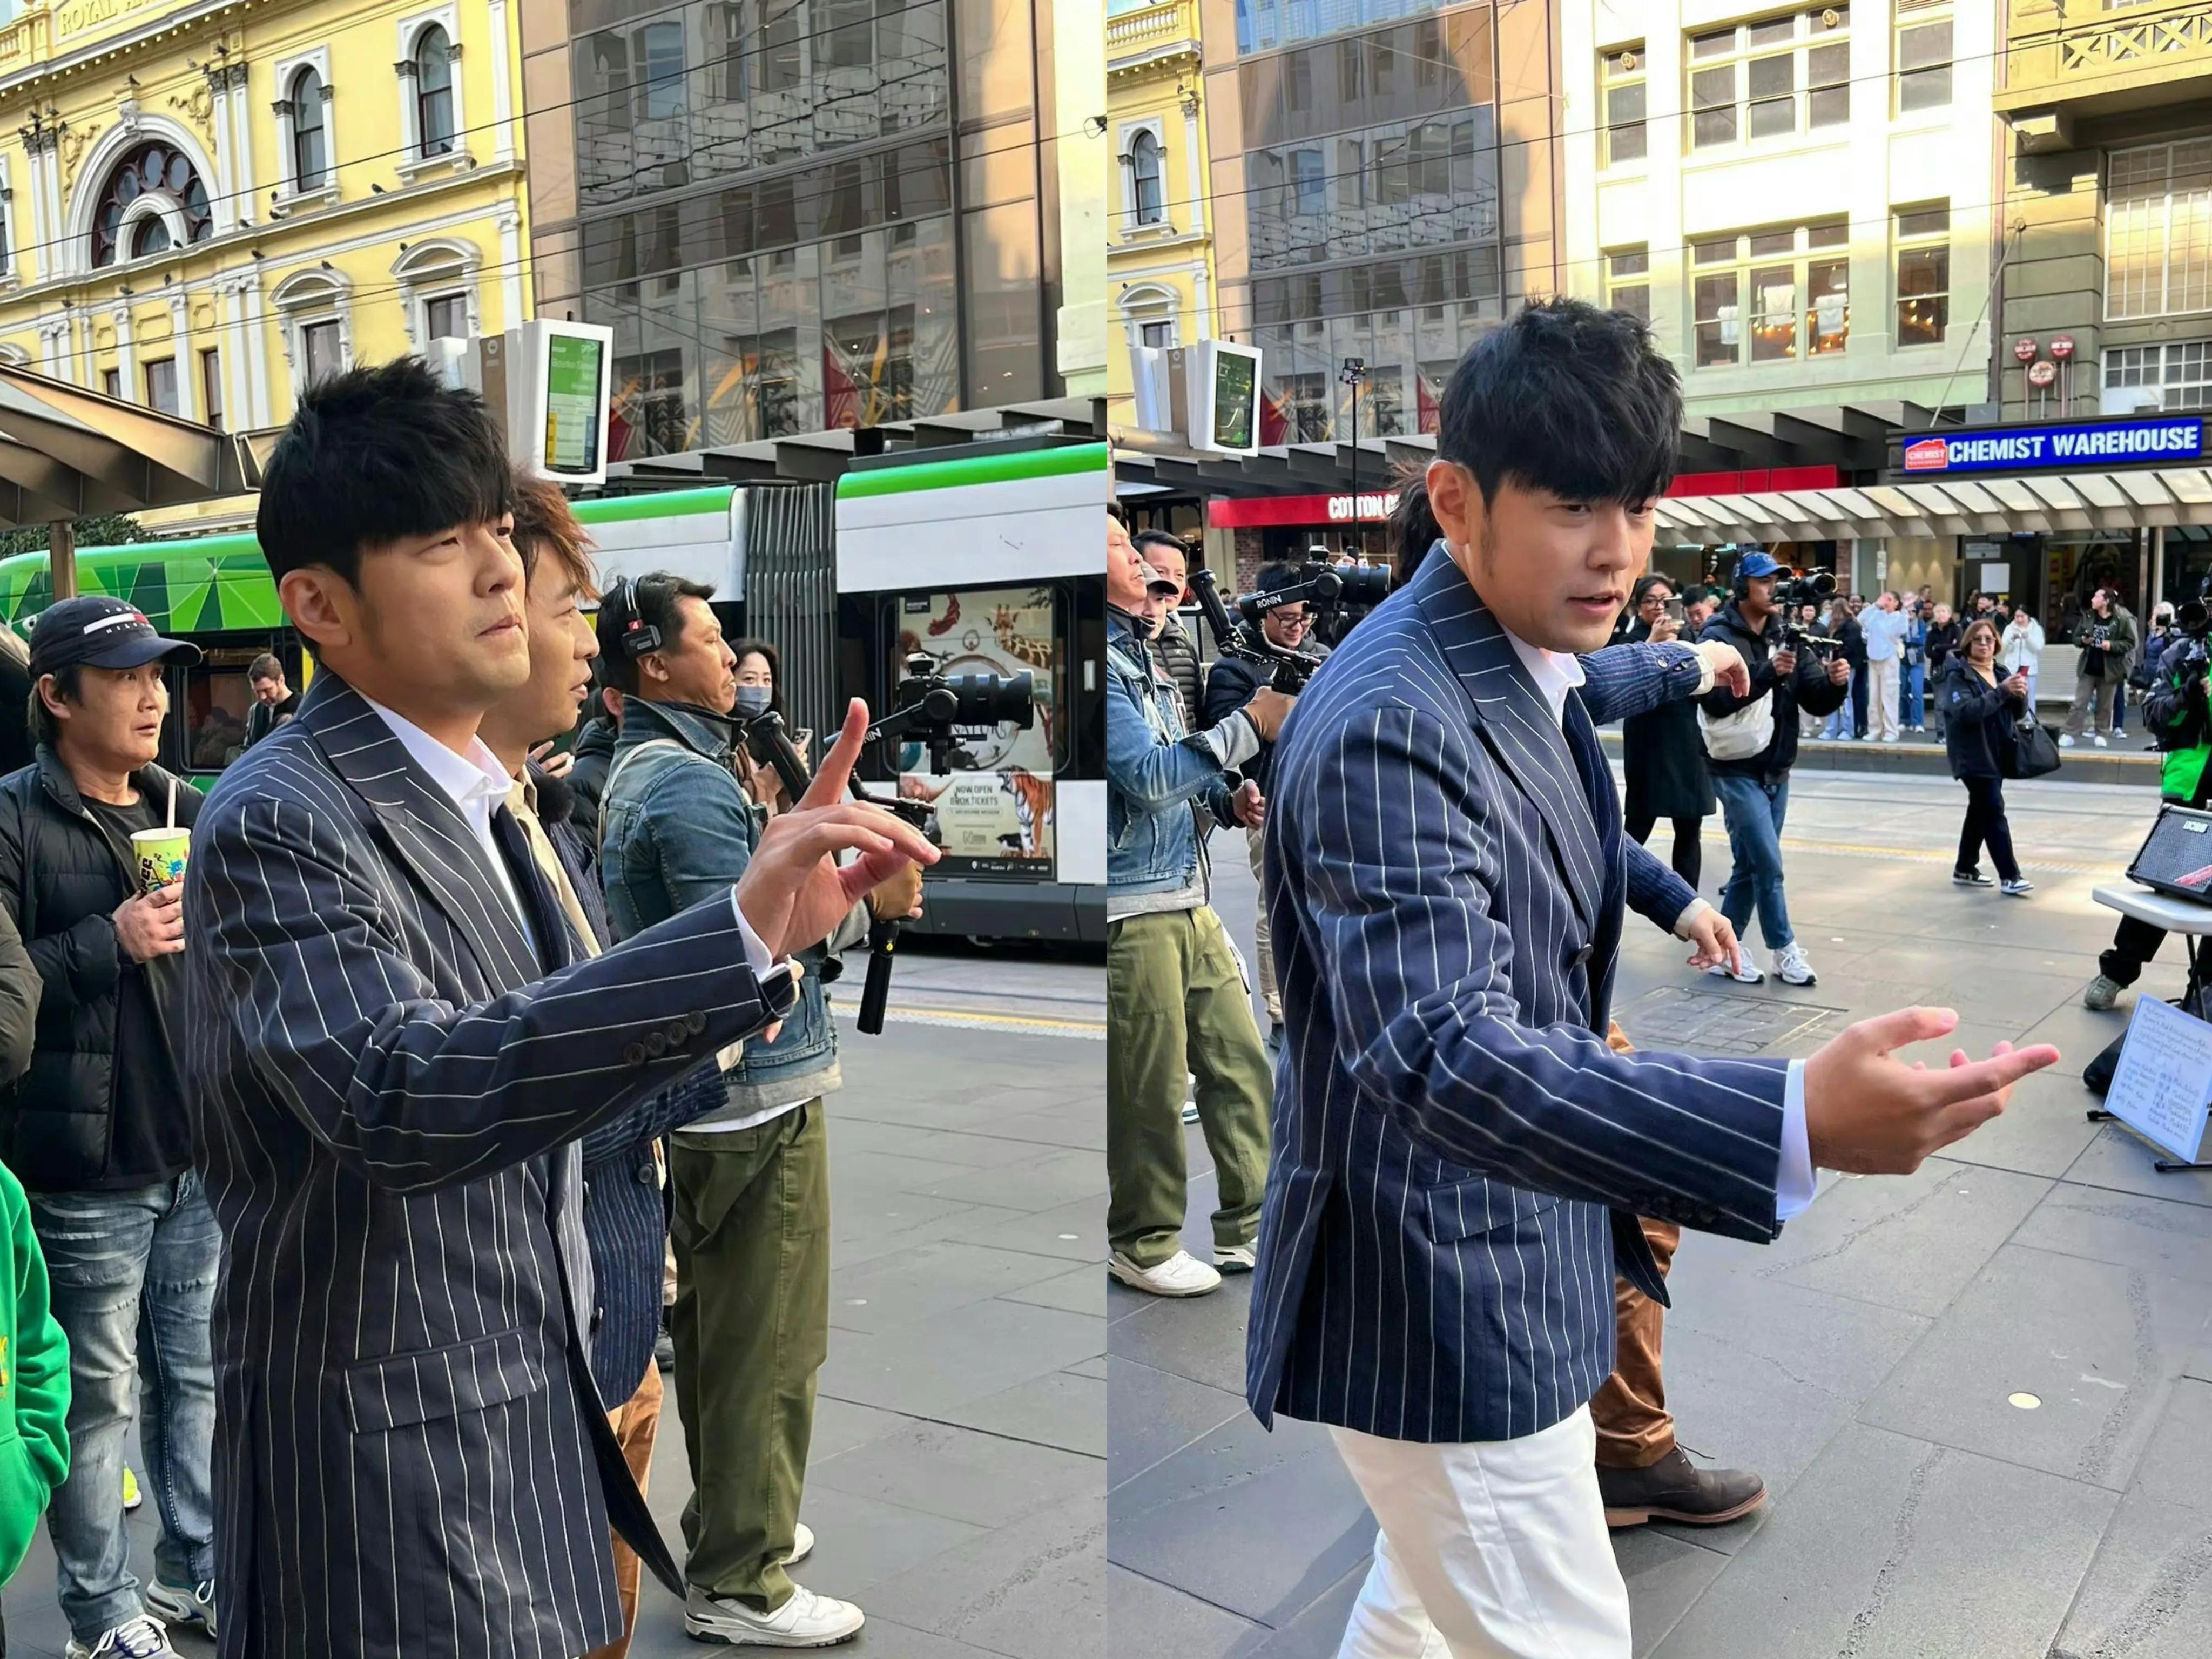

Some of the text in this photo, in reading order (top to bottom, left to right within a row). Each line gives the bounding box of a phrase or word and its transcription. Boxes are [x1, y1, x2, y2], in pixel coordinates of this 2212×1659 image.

[60, 0, 118, 36] ROYAL
[1948, 426, 2199, 463] CHEMIST WAREHOUSE
[1328, 494, 1384, 519] COTTON
[1256, 594, 1283, 609] RONIN
[955, 785, 993, 794] NOW OPEN
[970, 795, 999, 805] TICKETS
